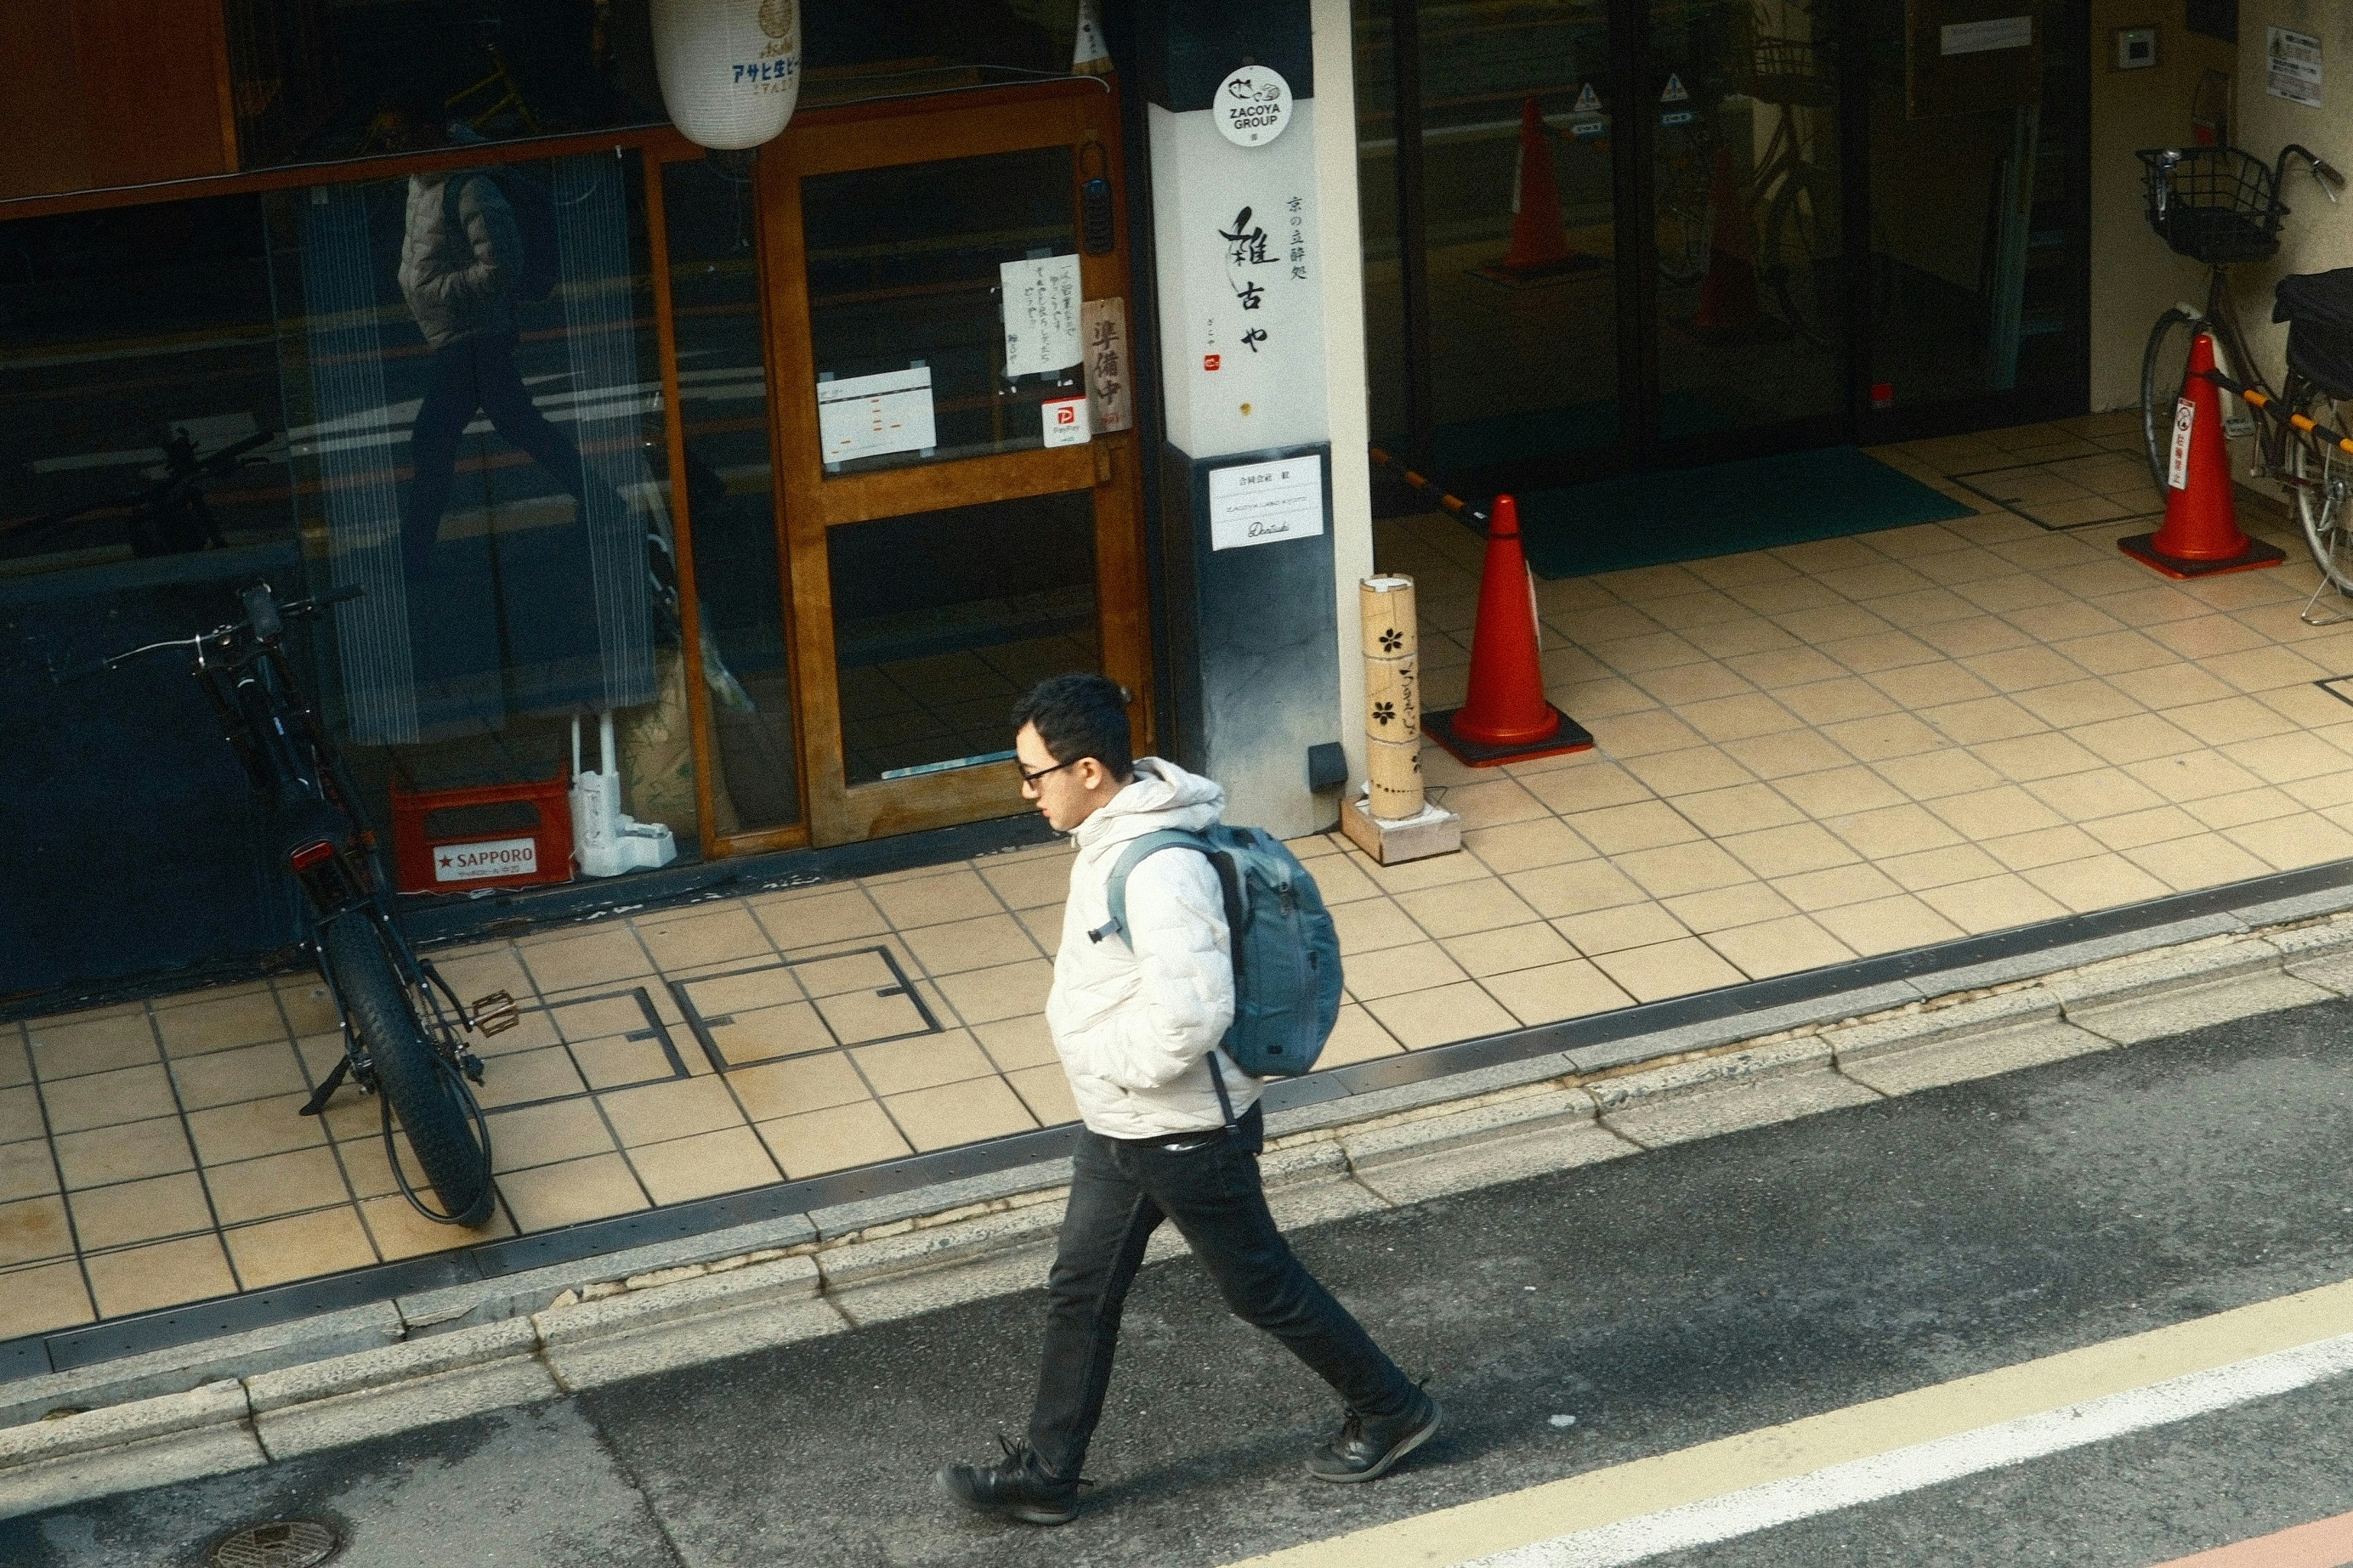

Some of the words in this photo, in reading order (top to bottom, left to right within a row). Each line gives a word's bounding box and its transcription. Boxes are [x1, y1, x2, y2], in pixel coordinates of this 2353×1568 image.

[1230, 104, 1280, 119] ZACOYA
[1234, 116, 1278, 130] GROUP
[1286, 196, 1307, 280] 京の立酔処
[1091, 320, 1121, 406] 準備中
[457, 847, 532, 867] SAPPORO
